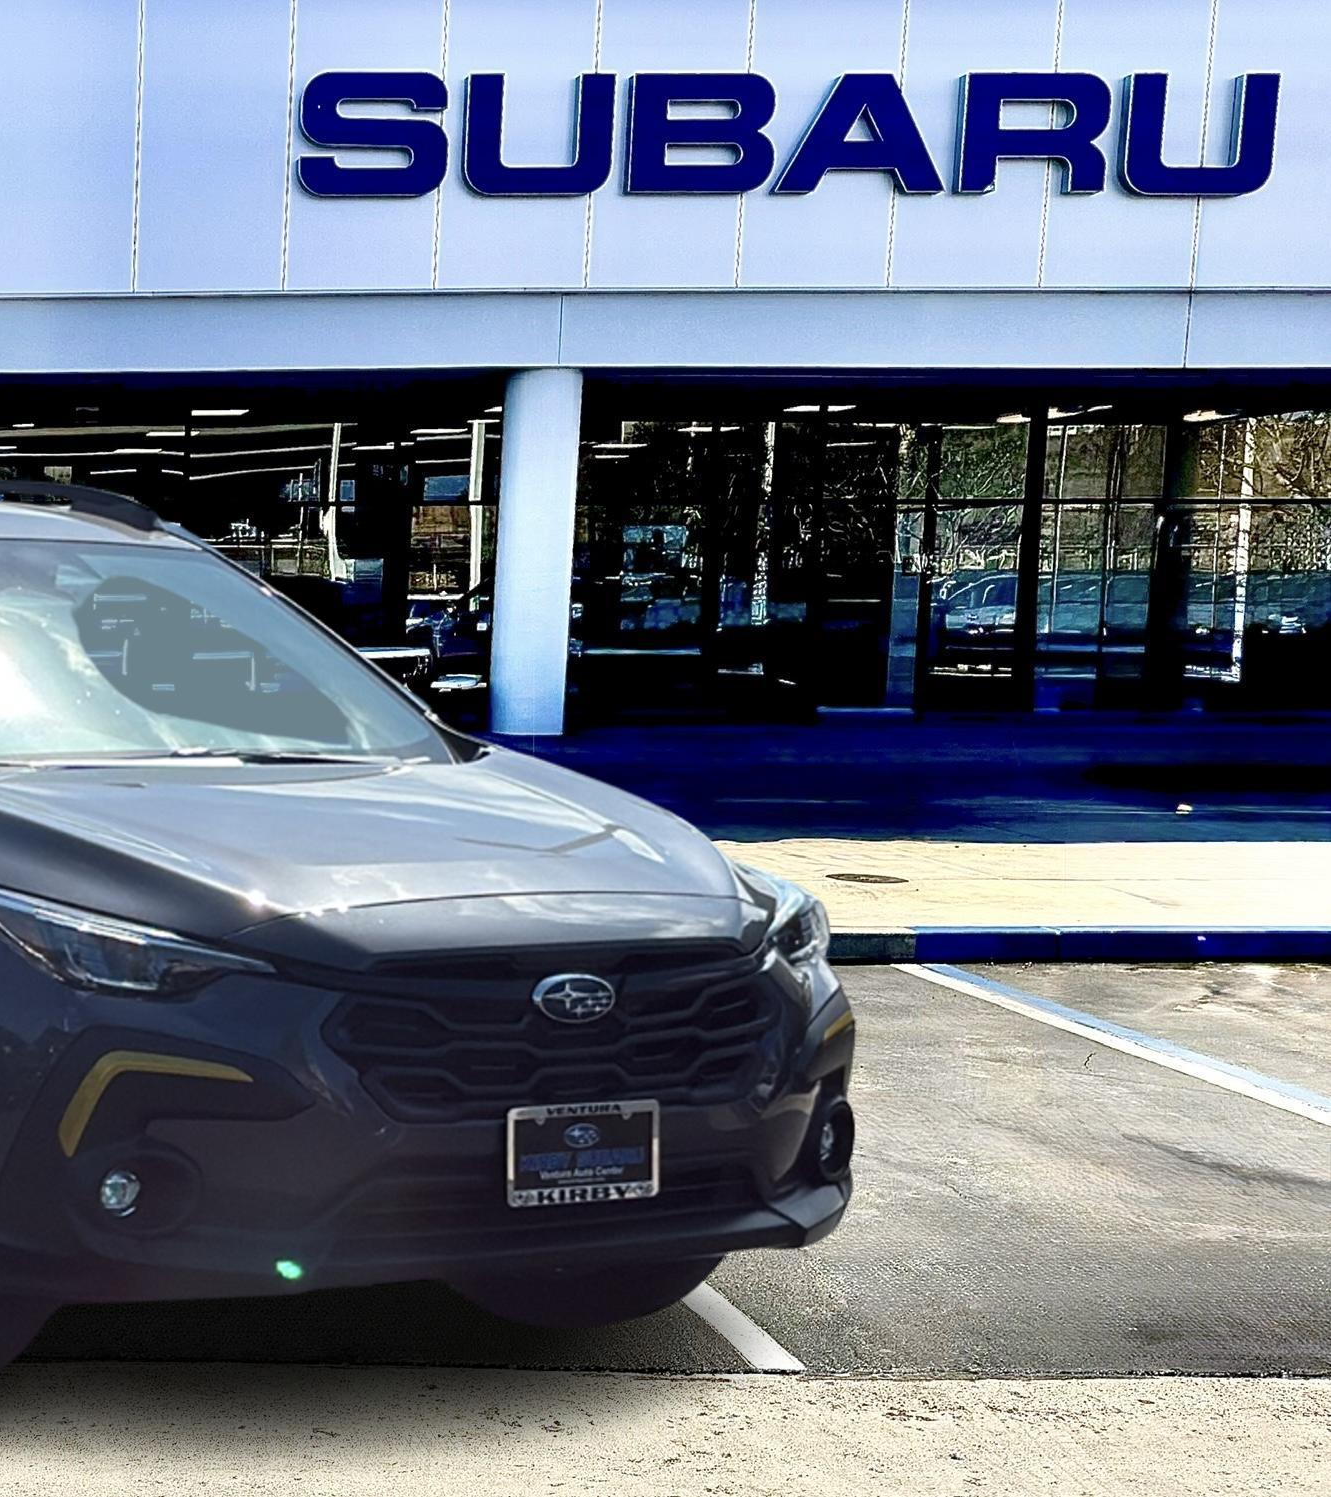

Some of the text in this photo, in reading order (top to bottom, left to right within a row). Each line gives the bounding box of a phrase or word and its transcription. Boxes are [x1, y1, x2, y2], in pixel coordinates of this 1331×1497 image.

[298, 71, 1281, 198] SUBARU
[546, 1104, 622, 1116] VENTURA
[539, 1166, 623, 1180] Ventura Auto Center
[538, 1185, 631, 1204] KIRBY
